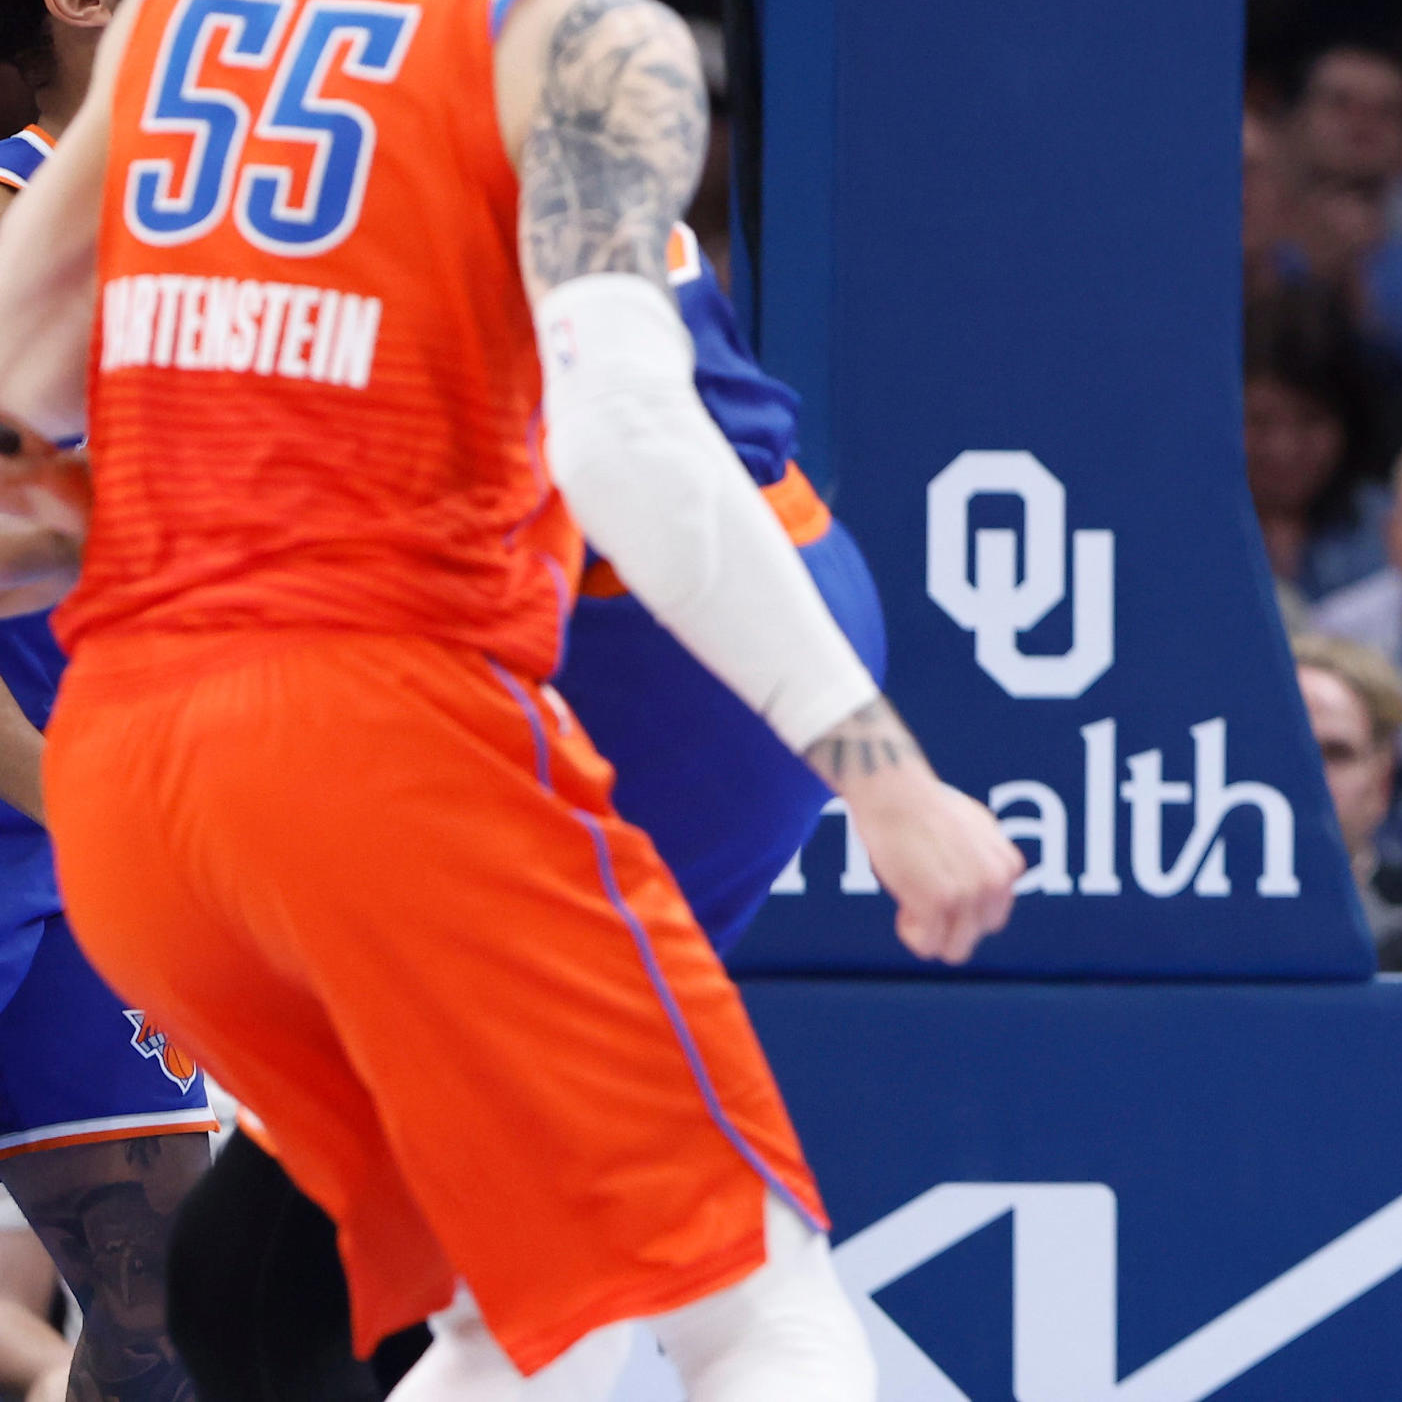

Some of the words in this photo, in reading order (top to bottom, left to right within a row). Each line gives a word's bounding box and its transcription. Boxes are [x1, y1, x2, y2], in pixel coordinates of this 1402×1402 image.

[100, 273, 382, 391] ARTENSTEIN
[926, 449, 1116, 699] OU
[770, 717, 1300, 897] alth
